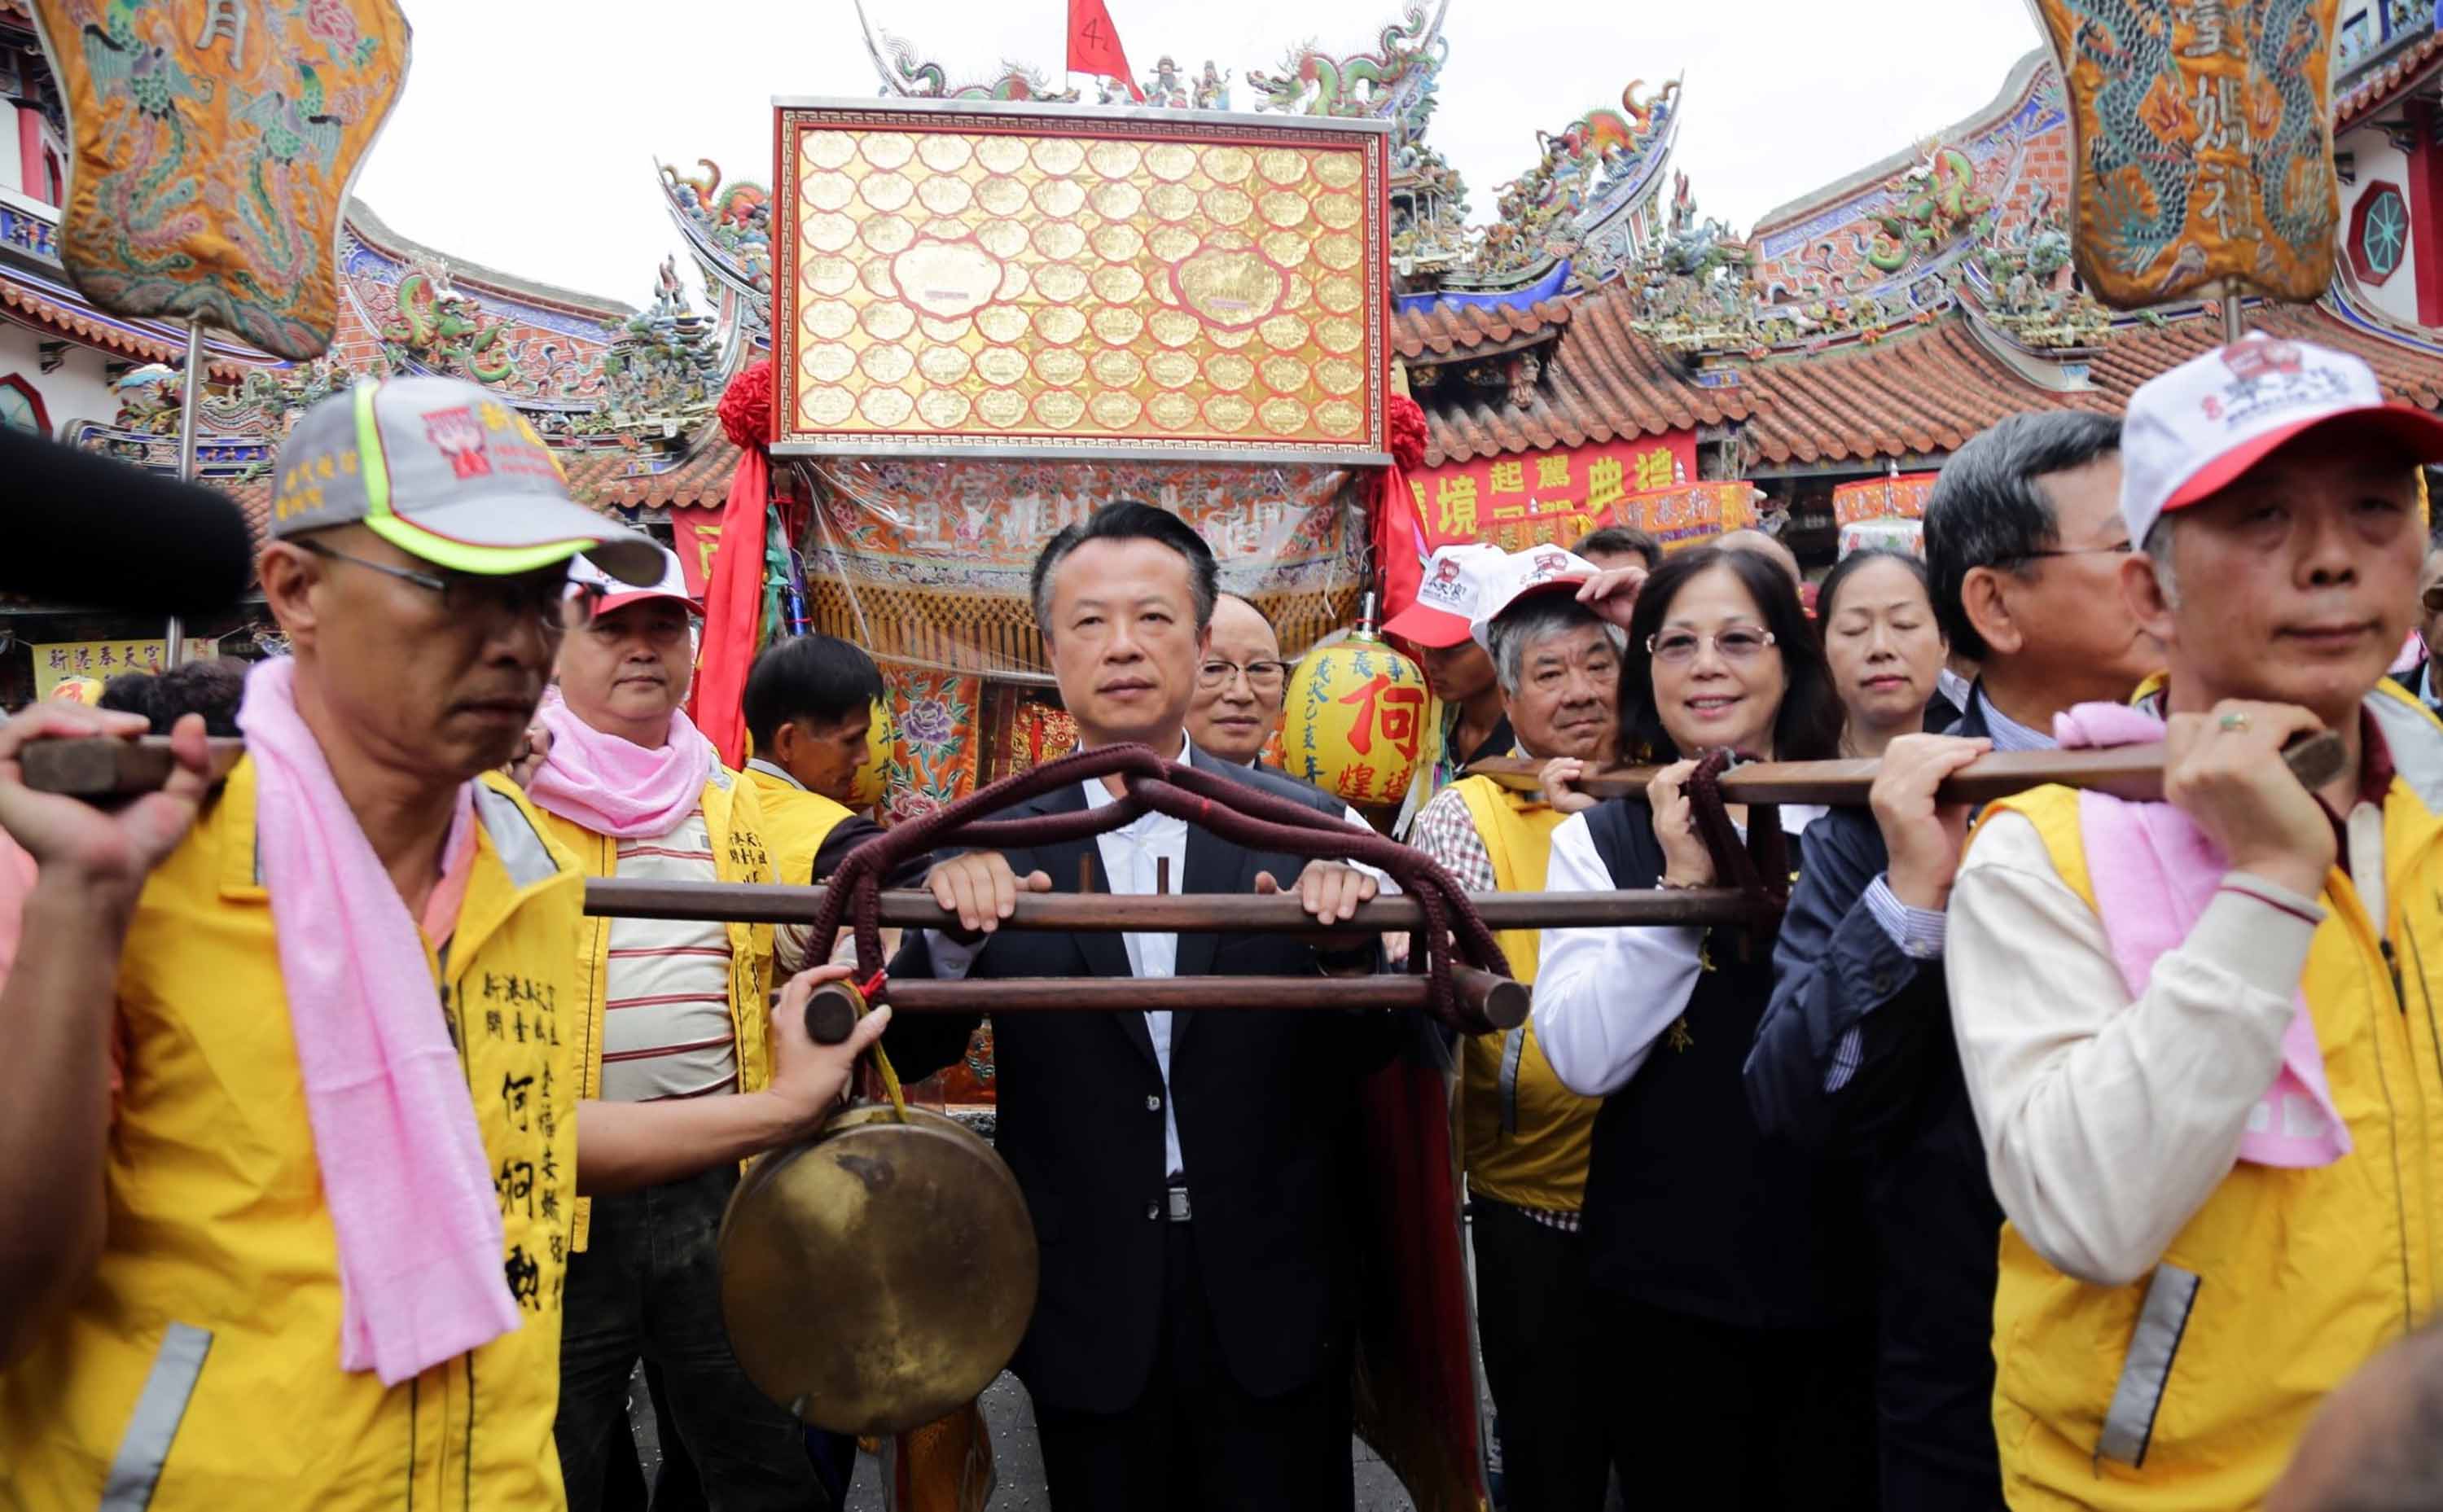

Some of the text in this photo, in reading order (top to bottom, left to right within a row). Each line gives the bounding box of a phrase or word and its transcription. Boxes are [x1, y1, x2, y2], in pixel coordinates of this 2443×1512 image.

[1490, 454, 1571, 495] 起駕
[1586, 446, 1674, 515] 典禮
[1339, 673, 1425, 762] 何
